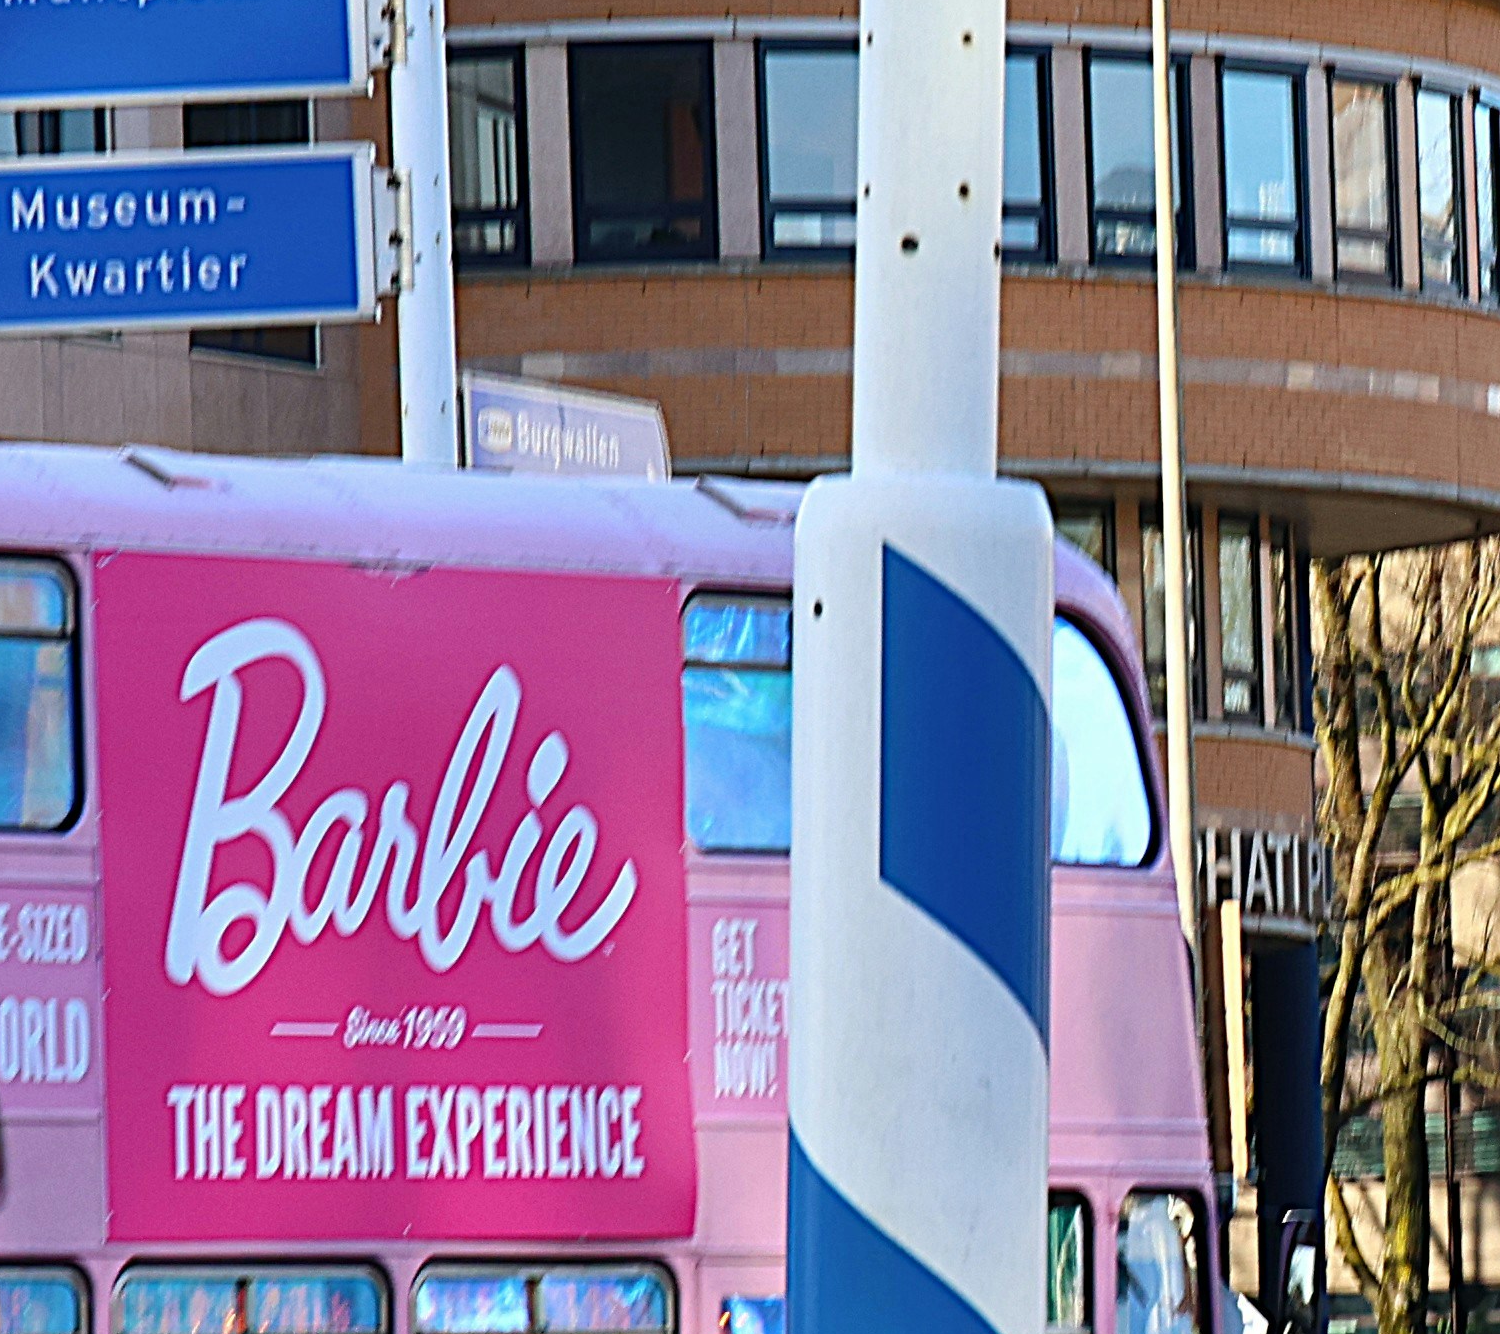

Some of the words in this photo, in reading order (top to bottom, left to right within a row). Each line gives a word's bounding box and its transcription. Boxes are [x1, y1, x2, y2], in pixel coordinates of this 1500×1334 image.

[12, 185, 246, 233] Museum-
[30, 246, 247, 299] Kwartier
[166, 617, 638, 996] Barbie
[712, 918, 758, 977] GET
[167, 1085, 247, 1181] THE
[256, 1085, 395, 1181] DREAM
[406, 1085, 646, 1181] EXPERIENCE
